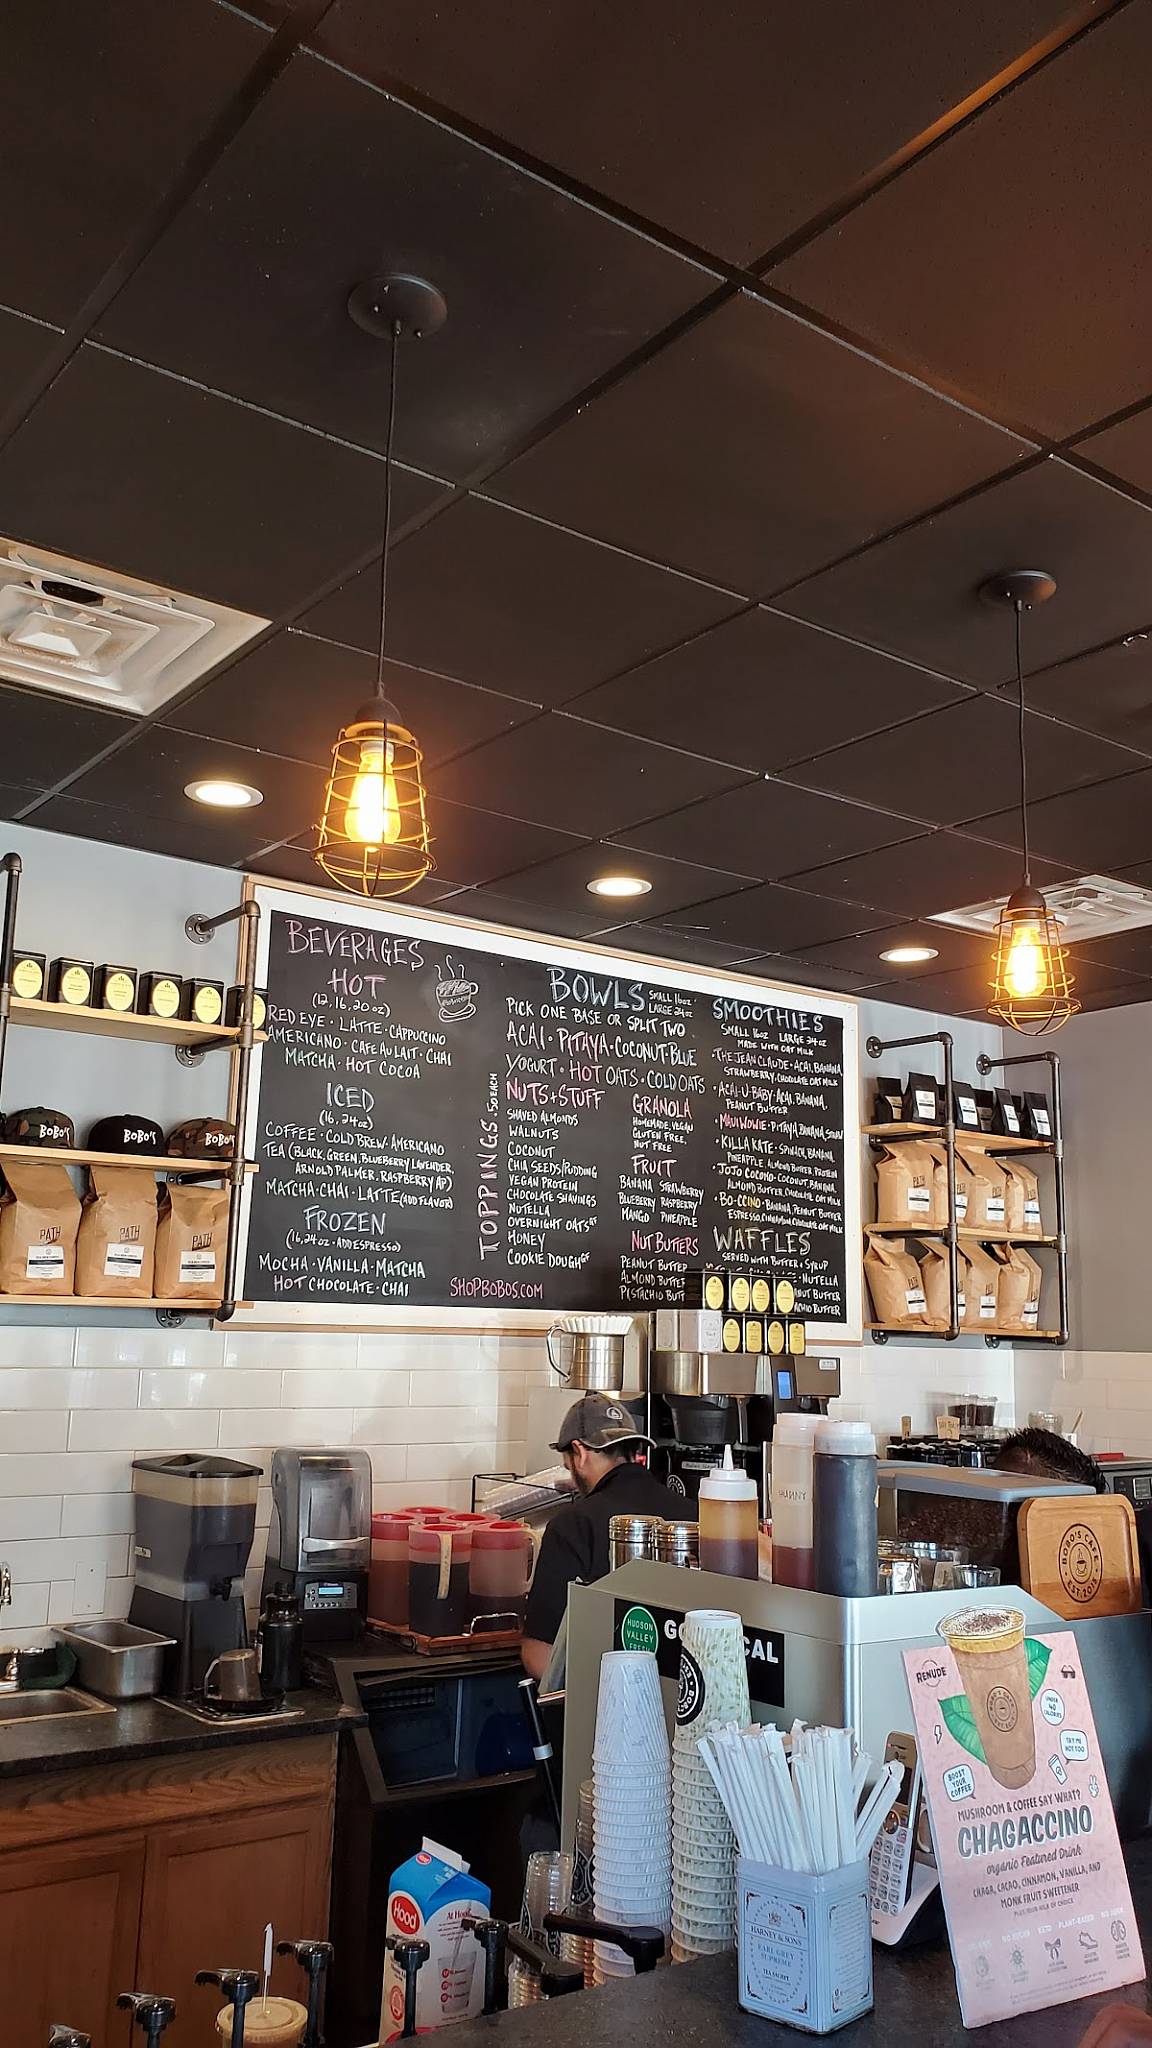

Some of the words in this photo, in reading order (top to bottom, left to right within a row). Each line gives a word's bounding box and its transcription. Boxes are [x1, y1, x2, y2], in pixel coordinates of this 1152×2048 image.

[285, 920, 424, 971] BEVERAGES
[327, 968, 386, 999] HOT
[546, 967, 646, 1012] BOWLS
[268, 1005, 295, 1025] RED
[300, 1014, 325, 1029] EYE
[340, 1017, 382, 1035] LATTE
[390, 1025, 447, 1046] CAPPUCCINO
[506, 997, 534, 1017] PICK
[540, 1005, 567, 1020] ONE
[571, 1007, 602, 1025] BASE
[607, 1013, 622, 1027] OR
[627, 1016, 658, 1034] SPLIT
[660, 1021, 685, 1038] TWO
[712, 998, 823, 1033] SMOOTHIES
[506, 1021, 545, 1050] ACAI
[557, 1028, 609, 1062] PITAYA
[614, 1036, 666, 1064] COCONUT
[669, 1042, 697, 1067] BLUE
[720, 1022, 750, 1038] SMALL
[778, 1032, 804, 1045] LARGE
[268, 1025, 342, 1050] AMERICANO
[352, 1040, 377, 1055] CAFE
[380, 1043, 392, 1058] AU
[394, 1046, 418, 1061] LAIT
[426, 1048, 451, 1067] CHAI
[285, 1047, 336, 1071] MATCHA
[346, 1056, 376, 1074] HOT
[380, 1061, 421, 1079] COCOA
[733, 1051, 756, 1067] JEAN
[757, 1055, 790, 1073] CLAUDE
[505, 1053, 557, 1078] YOGURT
[568, 1060, 602, 1084] HOT
[606, 1066, 638, 1087] OATS
[647, 1070, 676, 1092] COLD
[678, 1073, 706, 1095] OATS
[326, 1082, 375, 1113] ICED
[632, 1093, 692, 1120] GRANOLA
[725, 1098, 756, 1111] PEANUT
[757, 1102, 788, 1116] BUTTER
[506, 1108, 538, 1124] SHAVED
[540, 1110, 578, 1127] ALMONDS
[265, 1121, 317, 1142] COFFEE
[326, 1129, 353, 1146] COLD
[357, 1134, 388, 1150] BREW
[391, 1135, 445, 1156] AMERICANO
[508, 1124, 559, 1140] WALNUTS
[263, 1141, 286, 1159] TEA
[507, 1141, 556, 1159] COCONUT
[653, 1141, 672, 1153] FREE
[721, 1134, 750, 1152] KILLA
[752, 1138, 774, 1156] KATE
[507, 1158, 529, 1173] CHIA
[631, 1153, 677, 1178] FRUIT
[717, 1163, 742, 1178] JOJO
[295, 1162, 333, 1176] ARNOLD
[380, 1172, 434, 1193] RASPBERRY
[508, 1174, 539, 1188] VEGAN
[541, 1178, 578, 1193] PROTEIN
[265, 1178, 315, 1200] MATCHA
[319, 1183, 349, 1200] CHAI
[357, 1185, 400, 1204] LATTE
[476, 1118, 501, 1261] TOPPINGS
[506, 1188, 555, 1204] CHOCOLATE
[556, 1193, 597, 1208] SHAVINGS
[619, 1174, 654, 1193] BANANA
[659, 1179, 704, 1205] STRAWBERRY
[508, 1203, 551, 1218] NUTELLA
[617, 1191, 656, 1213] BLUEBERRY
[660, 1197, 698, 1216] RASPBERRY
[303, 1205, 387, 1237] FROZEN
[507, 1216, 563, 1231] OVERNIGHT
[621, 1207, 650, 1224] MANGO
[660, 1211, 698, 1228] PINEAPPLE
[39, 1226, 62, 1242] PATH
[119, 1225, 141, 1243] PATH
[192, 1232, 213, 1251] PATH
[507, 1232, 546, 1254] HONEY
[632, 1230, 654, 1252] NUT
[654, 1232, 699, 1257] BUTTERS
[712, 1225, 811, 1257] WAFFLES
[259, 1253, 309, 1272] MOCHA
[316, 1258, 370, 1276] VANILLA
[376, 1260, 426, 1280] MATCHA
[507, 1251, 545, 1268] COOKIE
[620, 1254, 655, 1271] PEANUT
[721, 1252, 749, 1264] SERVED
[750, 1255, 769, 1265] WITH
[771, 1257, 798, 1269] BUTTER
[805, 1258, 829, 1274] SYRUP
[273, 1276, 308, 1293] HOT
[308, 1279, 374, 1297] CHOCOLATE
[382, 1282, 409, 1298] CHAI
[620, 1269, 656, 1287] ALMOND
[802, 1275, 838, 1288] NUTELLA
[450, 1277, 544, 1302] SHOPBOBOS.COM
[619, 1284, 663, 1302] PISTACHIO
[813, 1288, 841, 1302] BUTTER
[813, 1303, 841, 1317] BUTTER
[1062, 1530, 1082, 1565] BOBO'S
[627, 1618, 654, 1631] HUDSON
[626, 1630, 654, 1644] VALLEY
[1048, 1703, 1057, 1711] 40
[948, 1768, 966, 1782] BOOST
[951, 1777, 967, 1789] YOUR
[950, 1784, 973, 1798] COFFEE
[957, 1804, 1006, 1823] MUSHROOM
[1006, 1804, 1012, 1814] &
[1013, 1797, 1038, 1812] COFFEE
[1038, 1794, 1054, 1808] SAY
[1054, 1789, 1082, 1805] WHAT?
[958, 1807, 1093, 1858] CHAGACCINO
[986, 1858, 1020, 1877] organic
[1020, 1850, 1059, 1870] Featured
[1059, 1844, 1082, 1863] Drink
[1089, 1862, 1101, 1874] AND
[1000, 1896, 1022, 1910] MONK
[1023, 1892, 1042, 1905] FRUIT
[1043, 1883, 1080, 1900] SWEETENER
[393, 1901, 418, 1930] Hood
[750, 1926, 777, 1940] HARNEY
[784, 1936, 803, 1946] SONS
